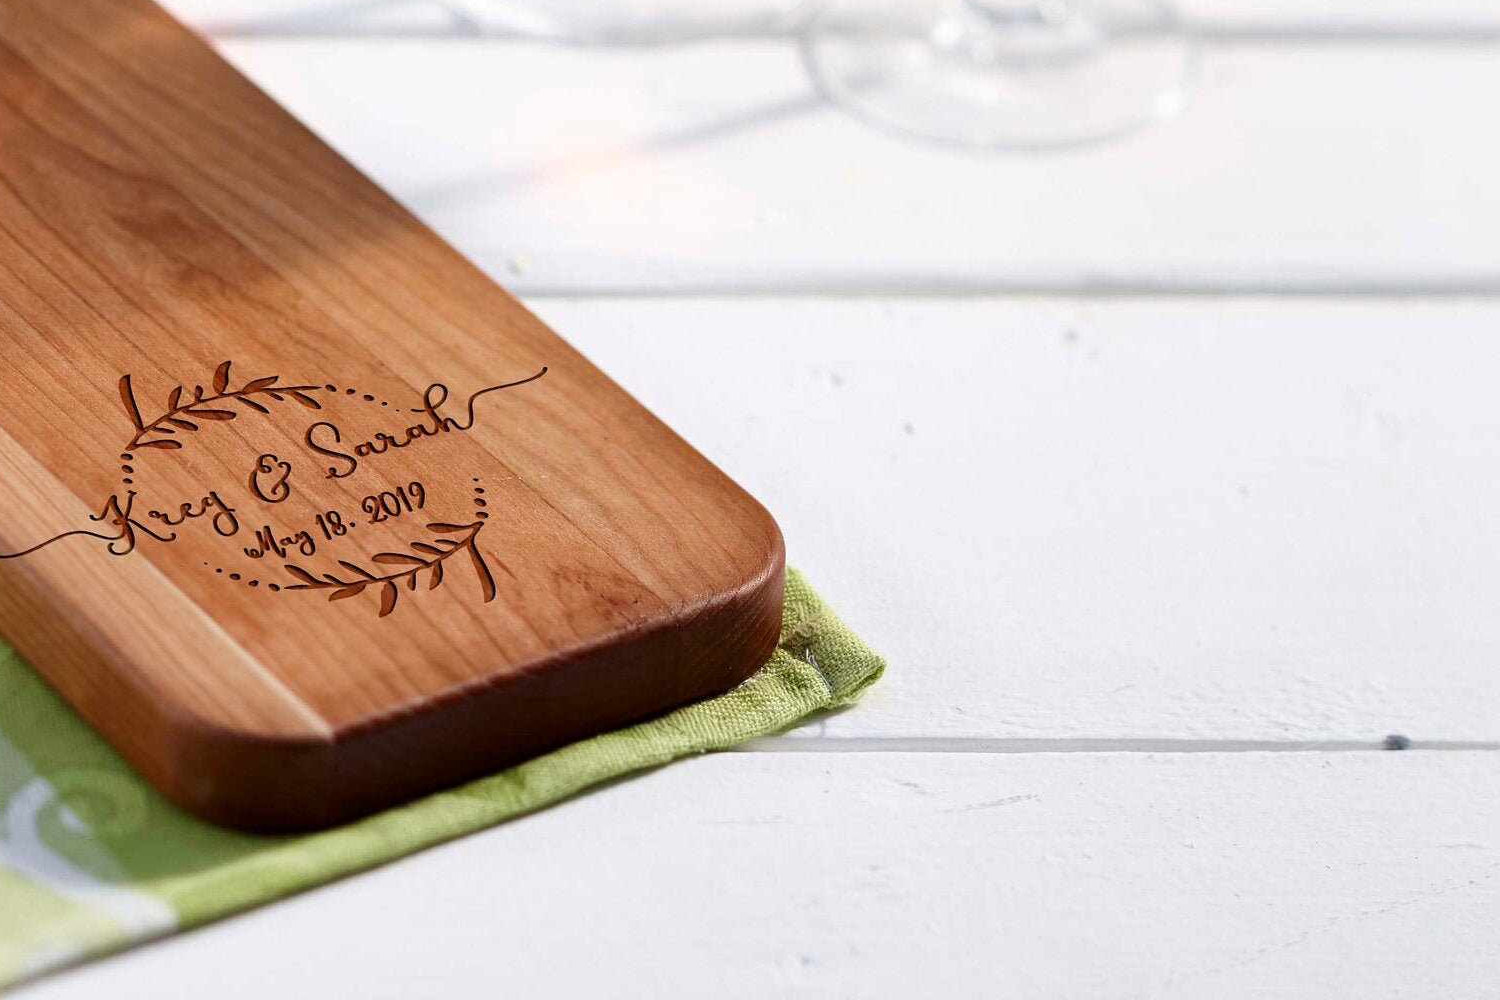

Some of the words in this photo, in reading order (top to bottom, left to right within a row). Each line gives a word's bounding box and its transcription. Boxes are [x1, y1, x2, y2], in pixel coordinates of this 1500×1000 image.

[248, 453, 292, 504] &
[304, 366, 548, 480] Sarah
[243, 525, 316, 559] May
[361, 481, 426, 525] 2019
